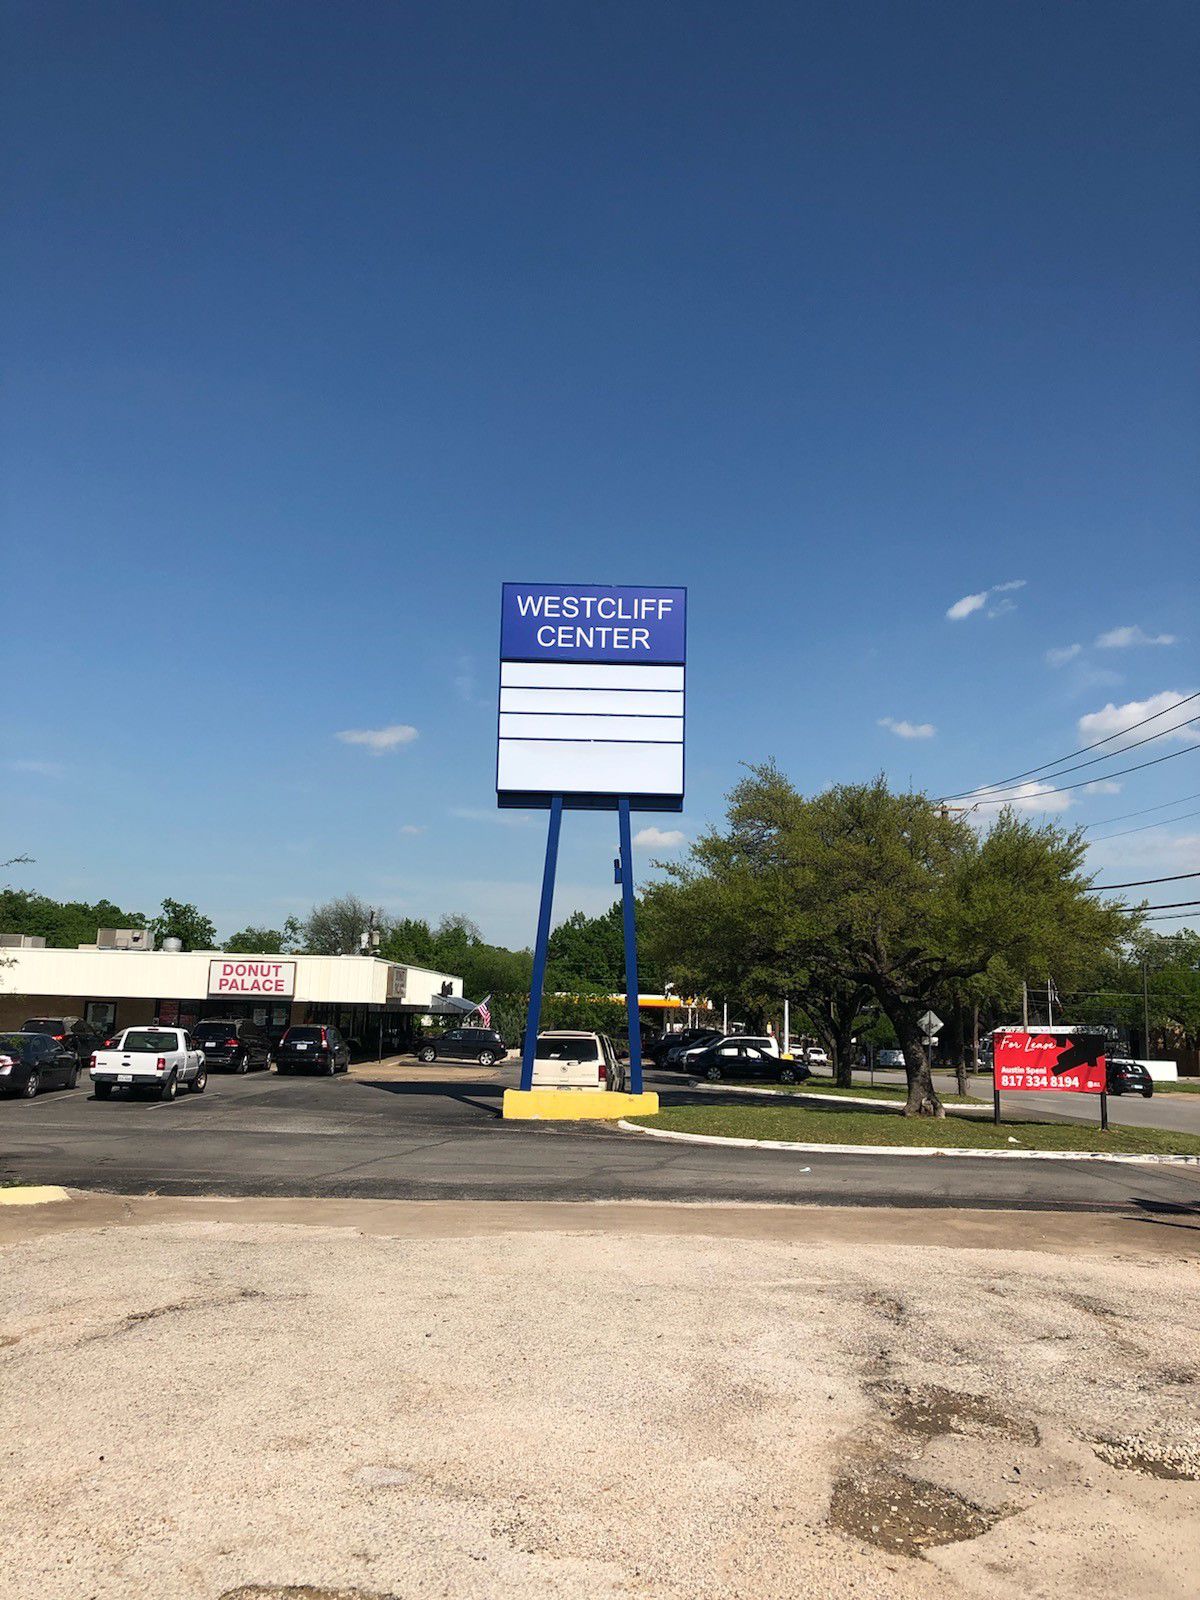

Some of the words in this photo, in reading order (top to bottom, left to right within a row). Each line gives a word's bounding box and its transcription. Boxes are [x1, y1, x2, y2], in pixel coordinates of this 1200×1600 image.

[517, 595, 673, 620] WESTCLIFF
[536, 626, 650, 650] CENTER
[223, 964, 282, 977] DONUT
[218, 978, 285, 992] PALACE
[1000, 1035, 1022, 1050] For
[1024, 1036, 1056, 1053] Lease
[1001, 1075, 1024, 1087] 817
[1026, 1075, 1048, 1087] 334
[1050, 1076, 1079, 1088] 8194
